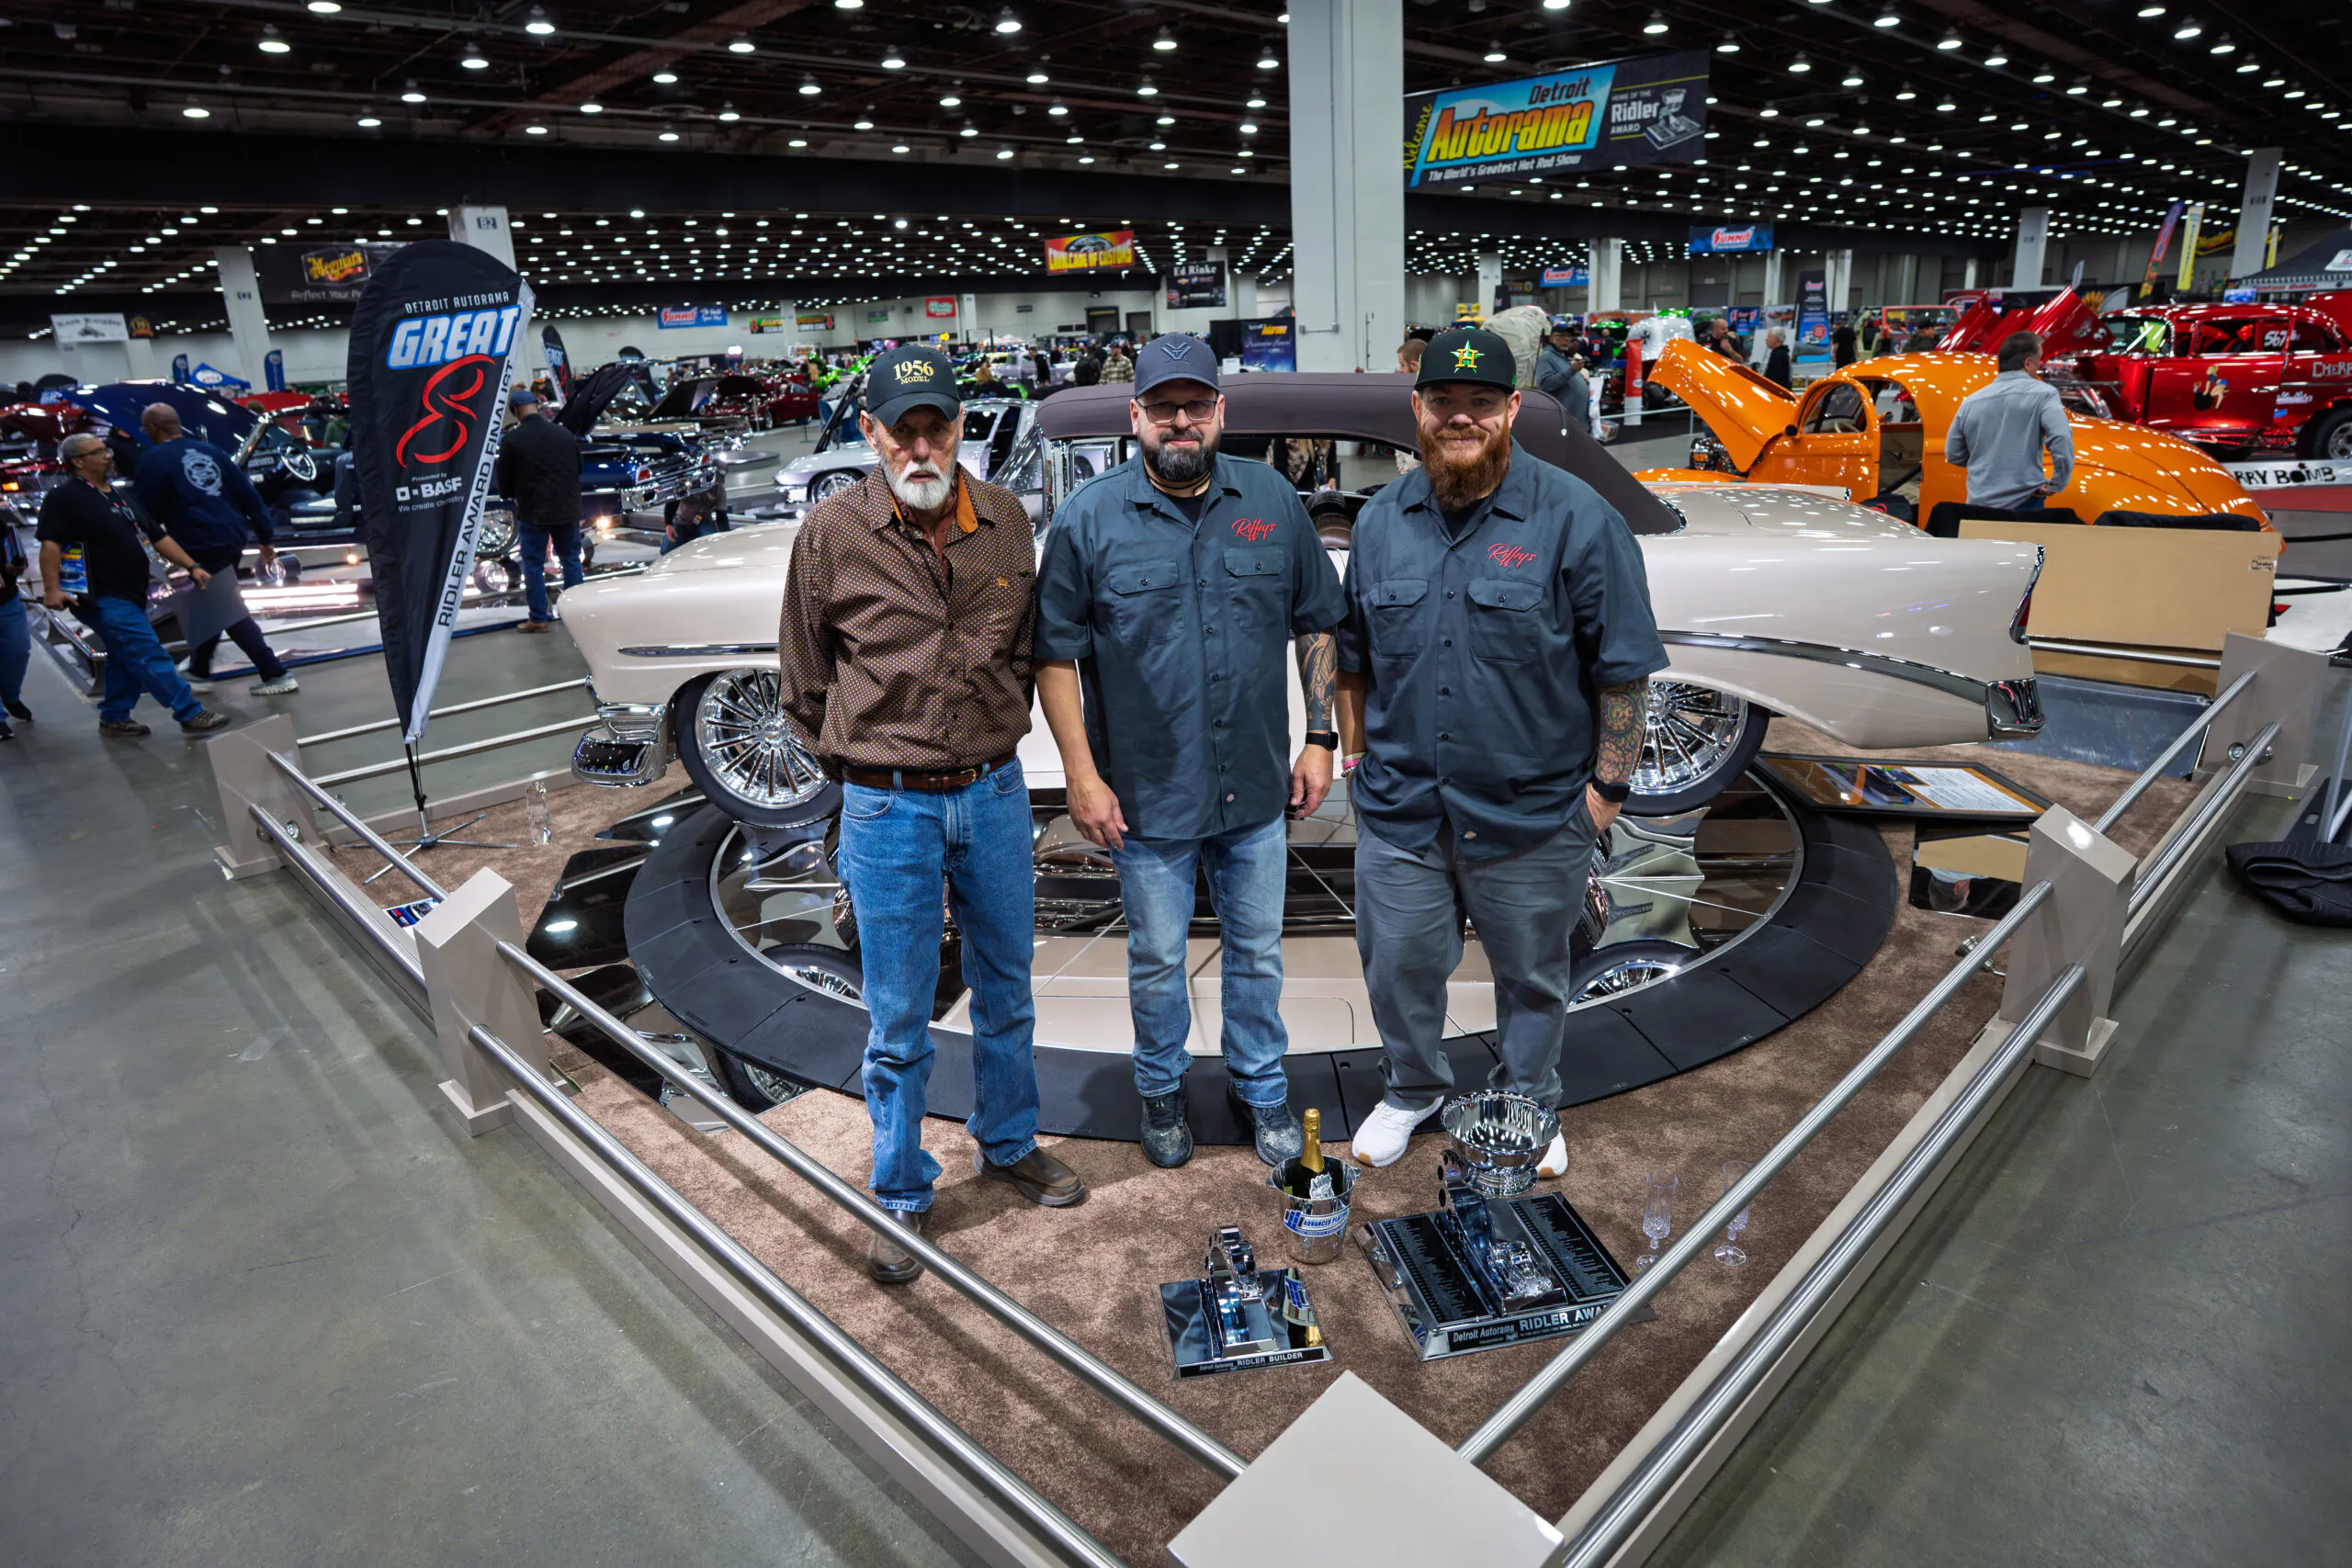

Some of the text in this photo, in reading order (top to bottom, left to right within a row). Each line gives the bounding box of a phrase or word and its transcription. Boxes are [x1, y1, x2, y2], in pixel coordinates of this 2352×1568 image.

[1529, 76, 1591, 106] Detroit
[1611, 100, 1660, 123] Ridler
[1404, 103, 1432, 169] Welcome
[1426, 100, 1595, 163] Autorama
[1610, 123, 1641, 135] AWARD
[1429, 154, 1581, 182] The World's Greatest Hot Rod Show
[307, 250, 363, 281] Meguiar's
[1173, 264, 1217, 276] Ed Rinke
[291, 289, 325, 301] Reflect
[404, 291, 510, 314] DETROIT AUTORAMA
[387, 304, 521, 369] GREAT
[1454, 348, 1478, 368] H
[893, 359, 934, 380] 1956
[900, 376, 930, 385] MODEL
[412, 473, 440, 482] Presented
[2274, 463, 2336, 485] BOMB
[420, 476, 462, 498] BASF
[437, 365, 514, 627] RIDLER AWARD FINALIST
[398, 504, 411, 513] We
[412, 501, 435, 511] create
[1303, 1218, 1332, 1227] ADVANCED
[1453, 1330, 1478, 1343] Detroit
[1480, 1325, 1515, 1339] Autorama
[1519, 1312, 1569, 1332] RIDLER
[1575, 1304, 1608, 1322] AWA
[1214, 1361, 1234, 1371] Autorama
[1237, 1356, 1266, 1367] RIDLER
[1269, 1351, 1304, 1363] BUILDER
